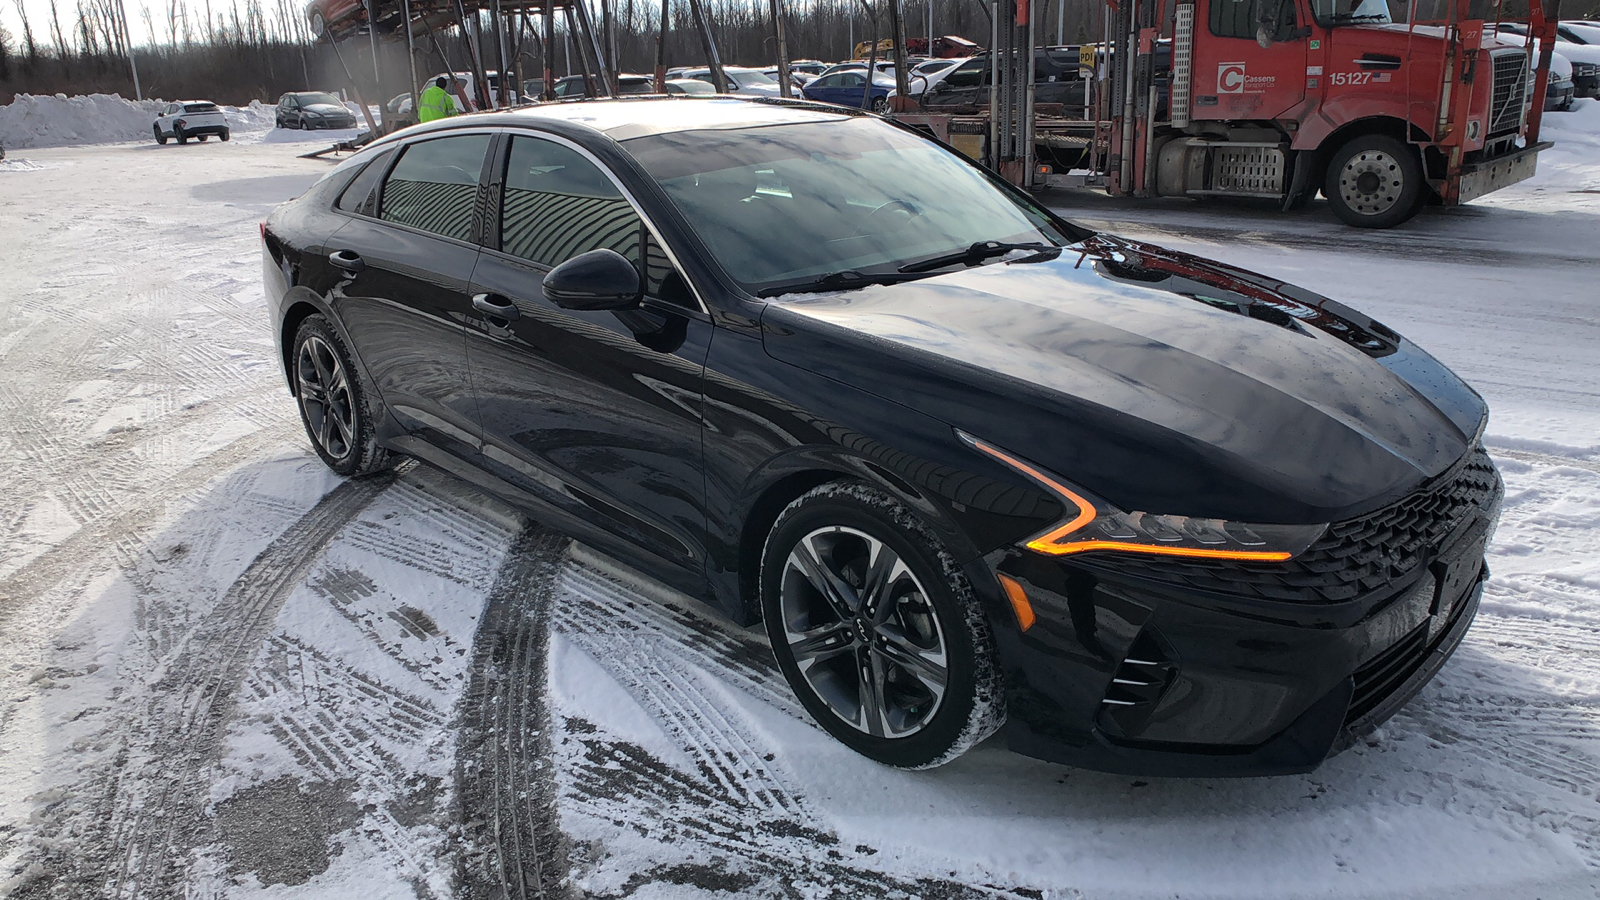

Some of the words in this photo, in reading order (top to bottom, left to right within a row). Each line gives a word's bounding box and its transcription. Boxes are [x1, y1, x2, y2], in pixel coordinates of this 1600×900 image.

[1531, 7, 1540, 16] 27
[1467, 30, 1477, 39] 27
[1080, 52, 1093, 61] PDI
[1244, 75, 1275, 83] Cassens
[1329, 72, 1372, 85] 15127
